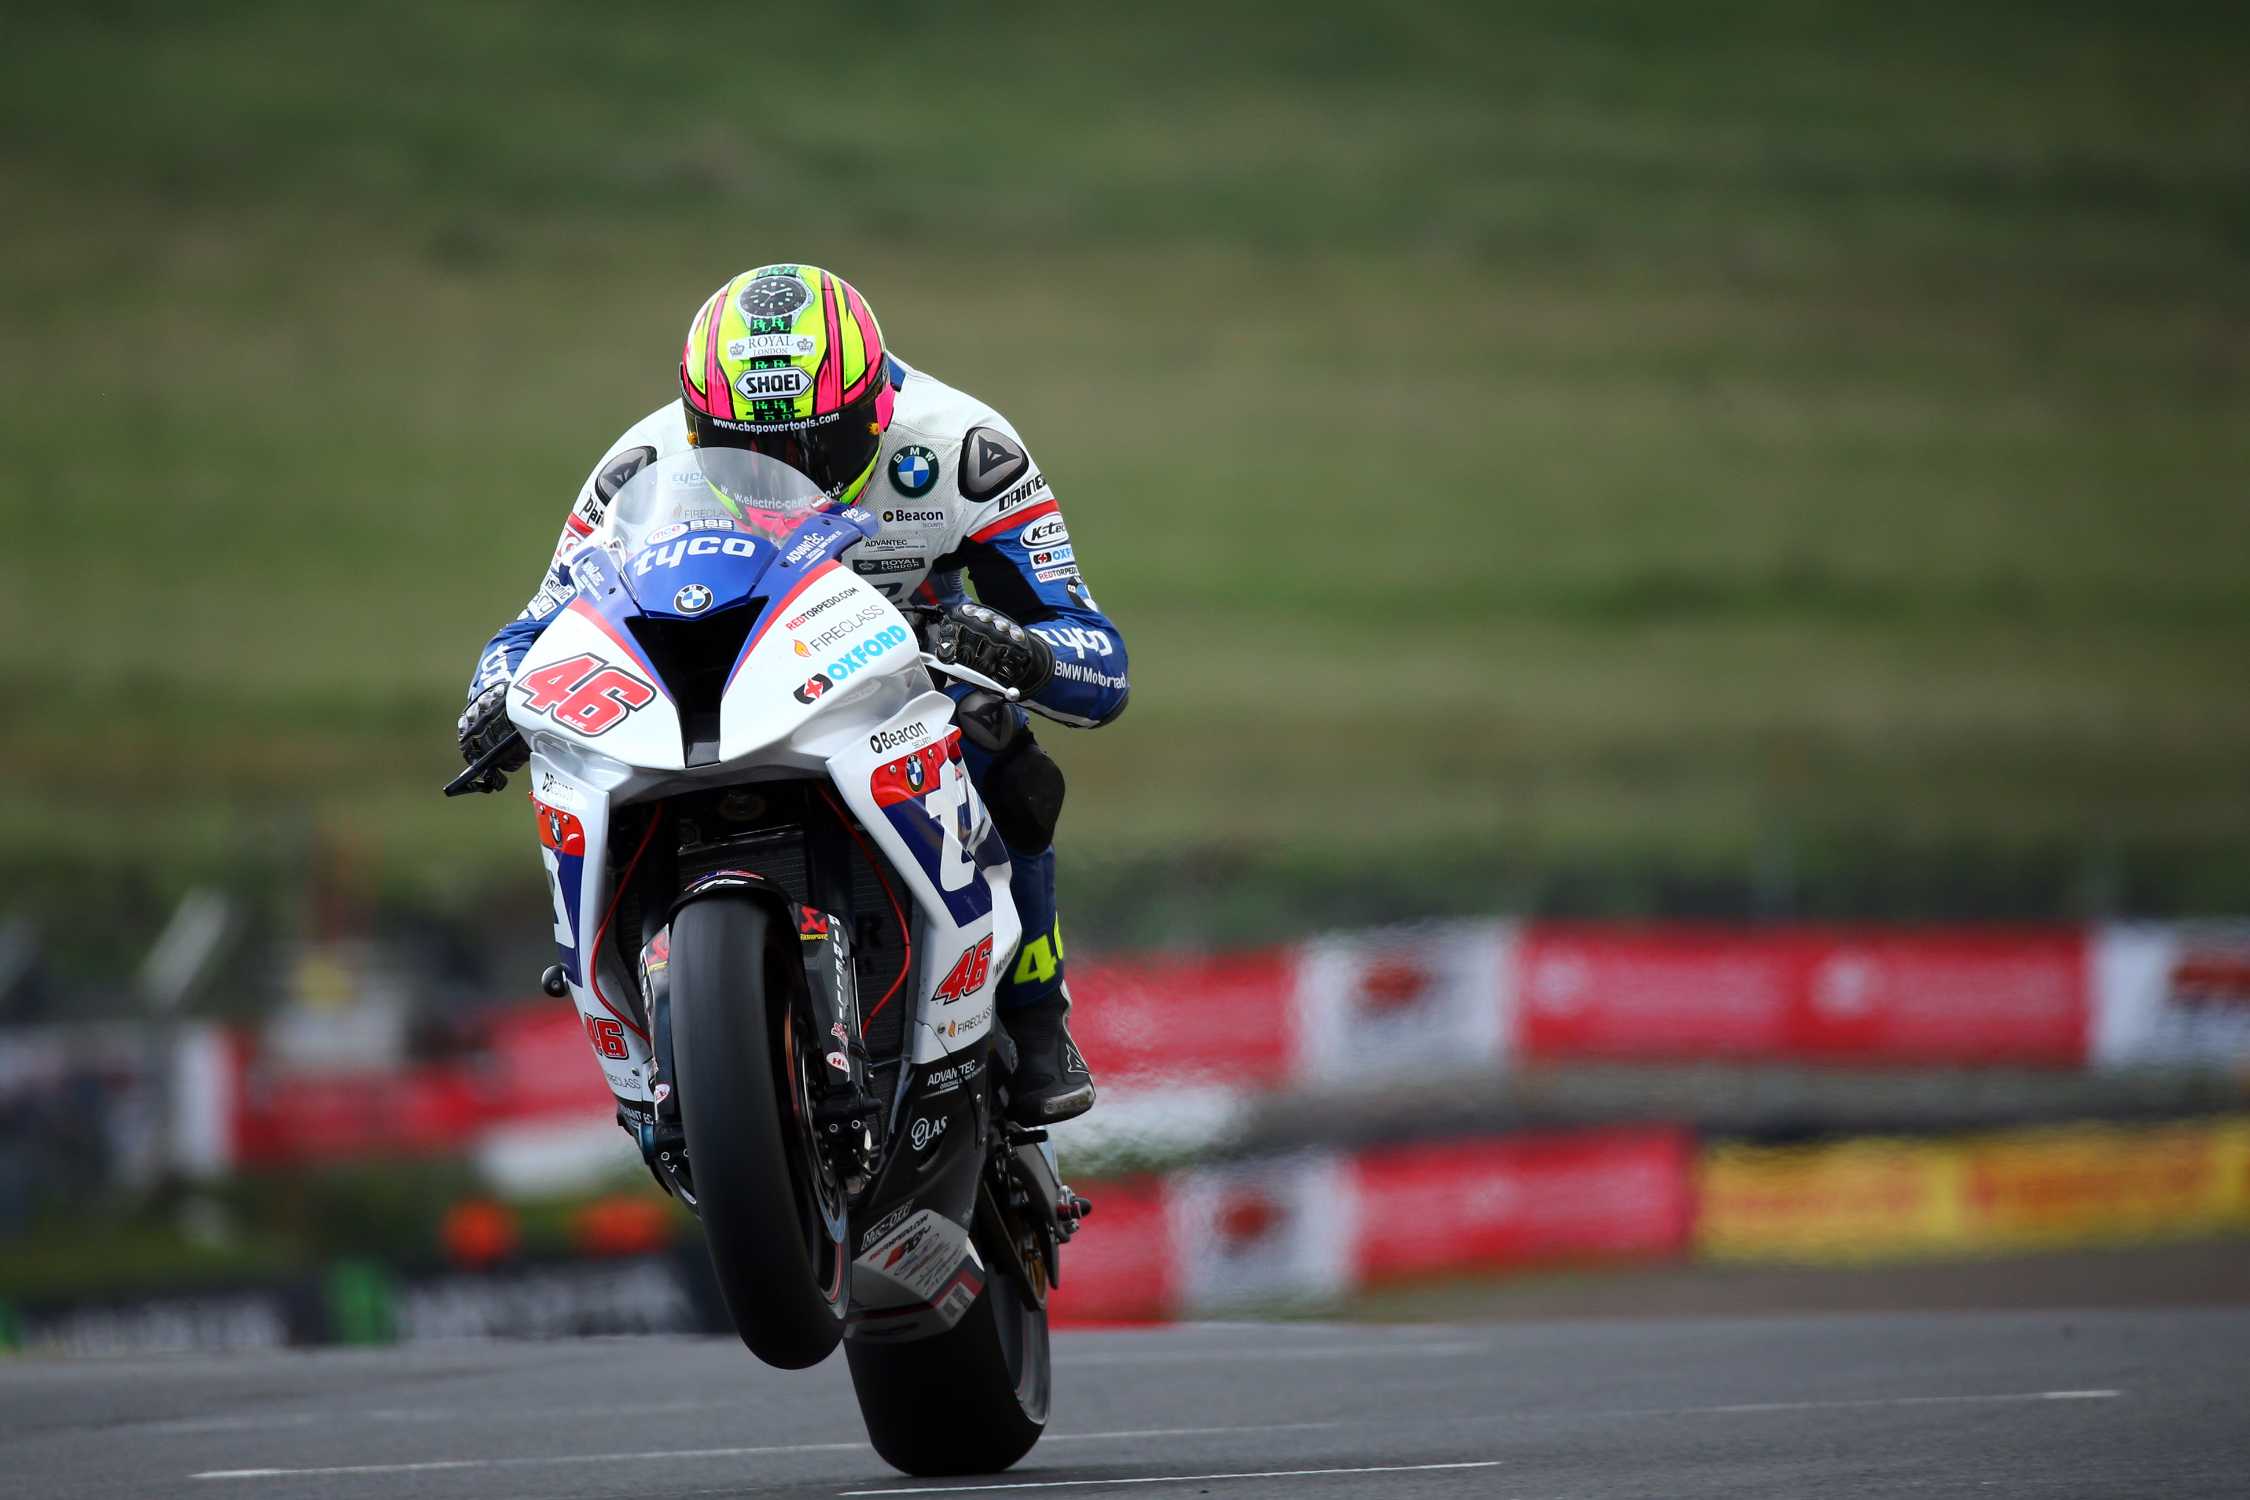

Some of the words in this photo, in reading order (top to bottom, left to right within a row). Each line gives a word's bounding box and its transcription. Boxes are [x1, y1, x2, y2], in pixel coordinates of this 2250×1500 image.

[748, 336, 794, 348] ROYAL
[753, 347, 789, 357] LONDON
[746, 374, 800, 394] SHOEI
[712, 412, 840, 435] www.cbspowertools.com
[893, 446, 936, 464] BMW
[895, 509, 944, 522] Beacon
[864, 539, 907, 548] ADVANTEC
[1052, 548, 1072, 560] OXF
[633, 536, 756, 576] tyco
[785, 586, 860, 631] REDTORPEDO.COM
[809, 604, 885, 651] FIRECLASS
[827, 624, 907, 681] OXFORD
[1054, 660, 1081, 681] BMW
[513, 652, 657, 737] 46
[879, 721, 929, 750] Beacon
[827, 913, 847, 1020] PIRELLI
[931, 932, 994, 1006] 46
